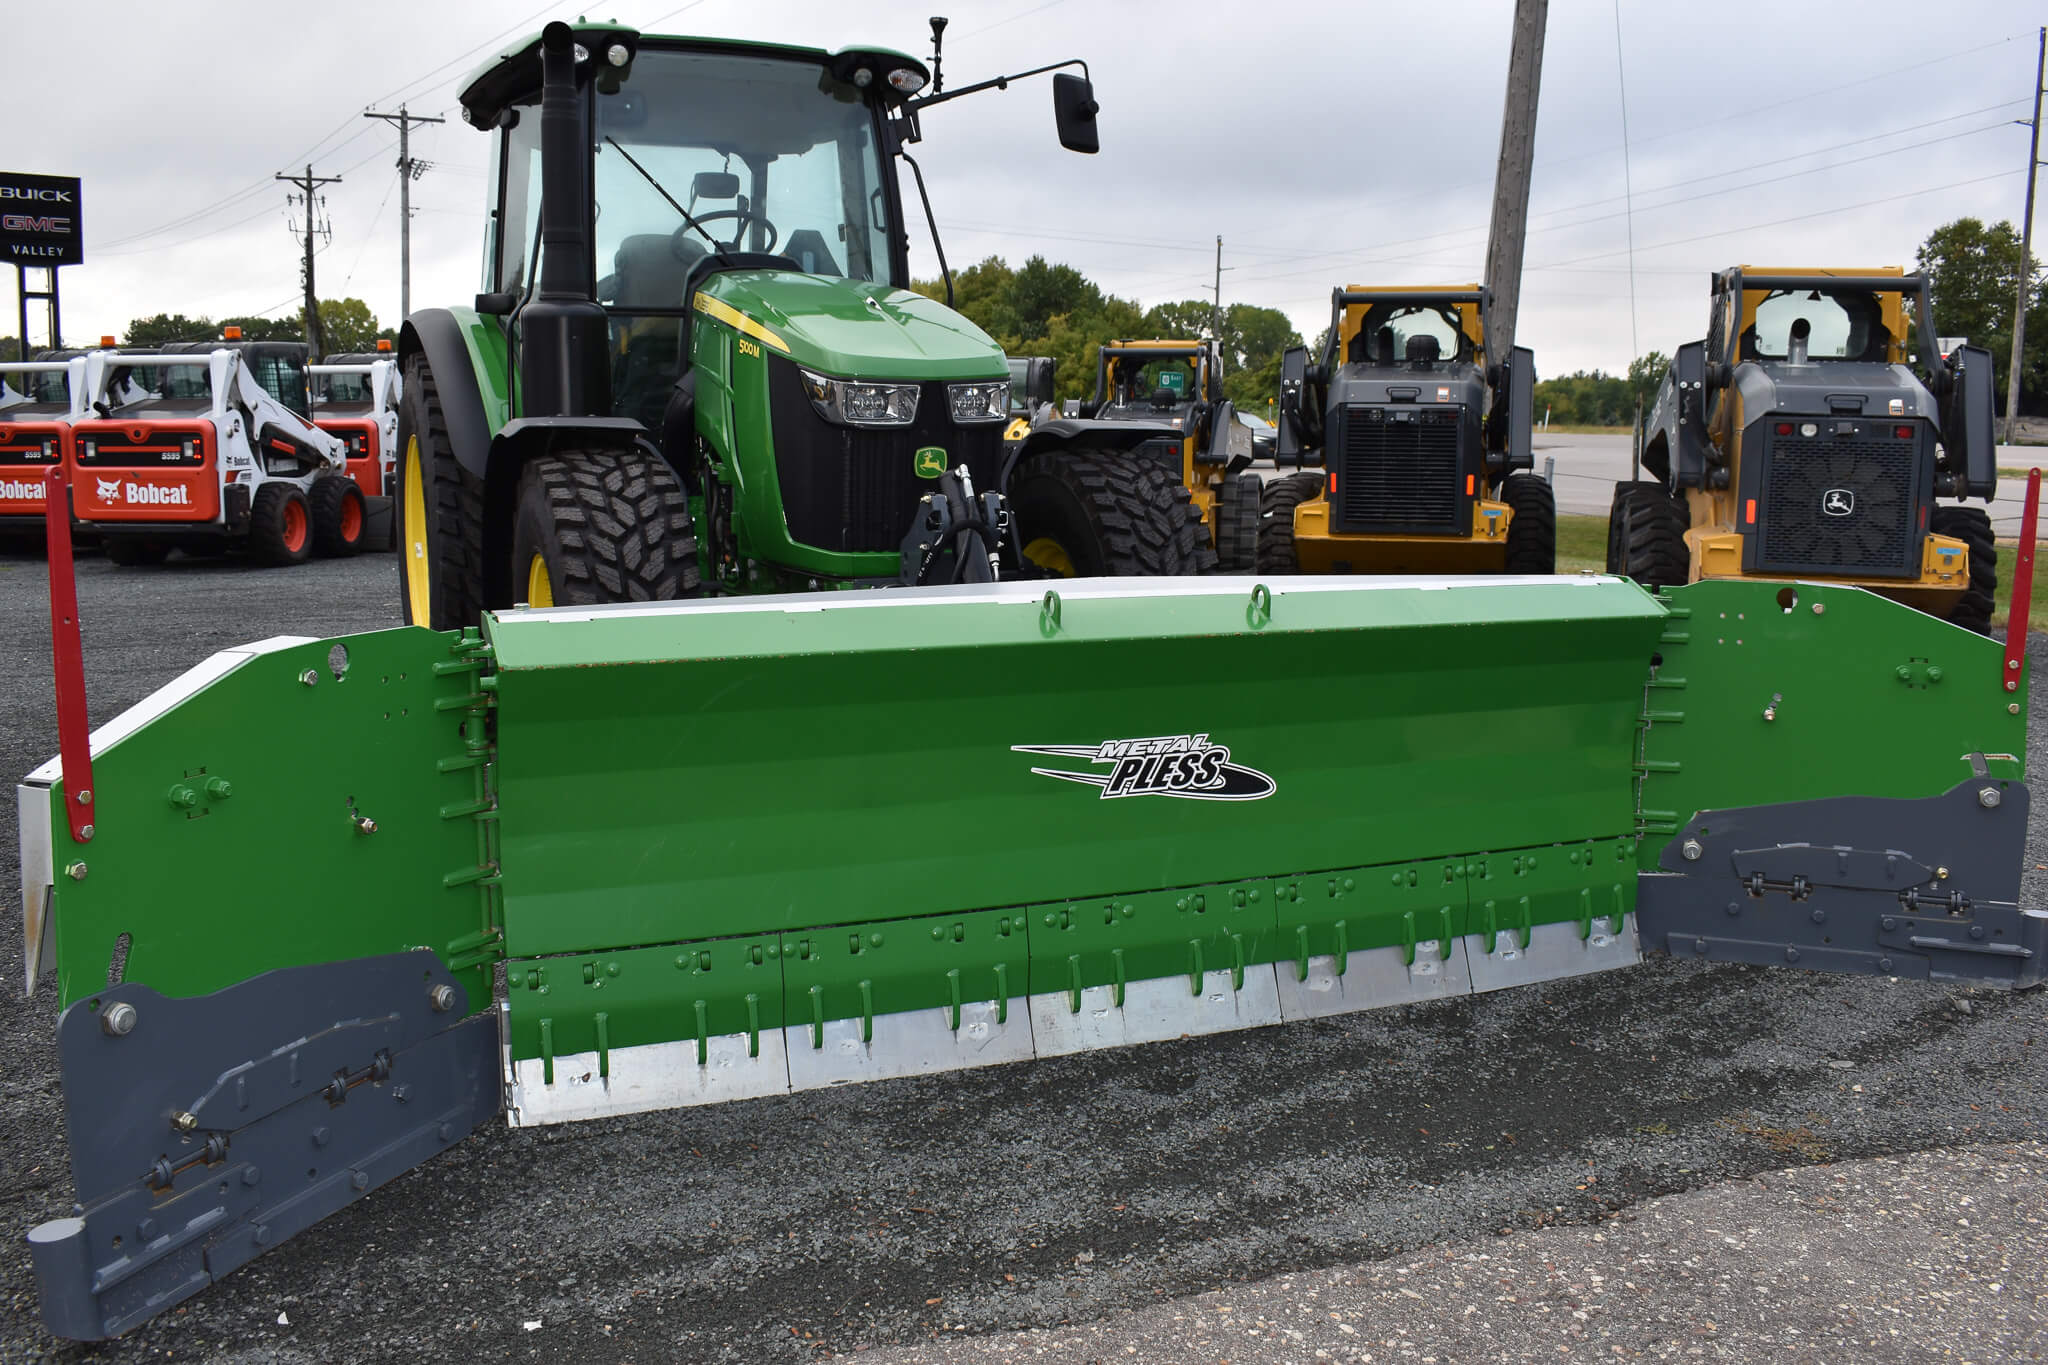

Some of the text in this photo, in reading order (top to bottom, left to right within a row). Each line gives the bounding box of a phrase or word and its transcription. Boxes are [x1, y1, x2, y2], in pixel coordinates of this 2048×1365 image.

[0, 187, 72, 202] BUICK
[3, 214, 71, 233] GMC
[12, 244, 64, 256] VALLEY
[126, 482, 188, 505] Bobcat
[1097, 734, 1213, 759] METAL
[1104, 751, 1226, 797] PLESS
